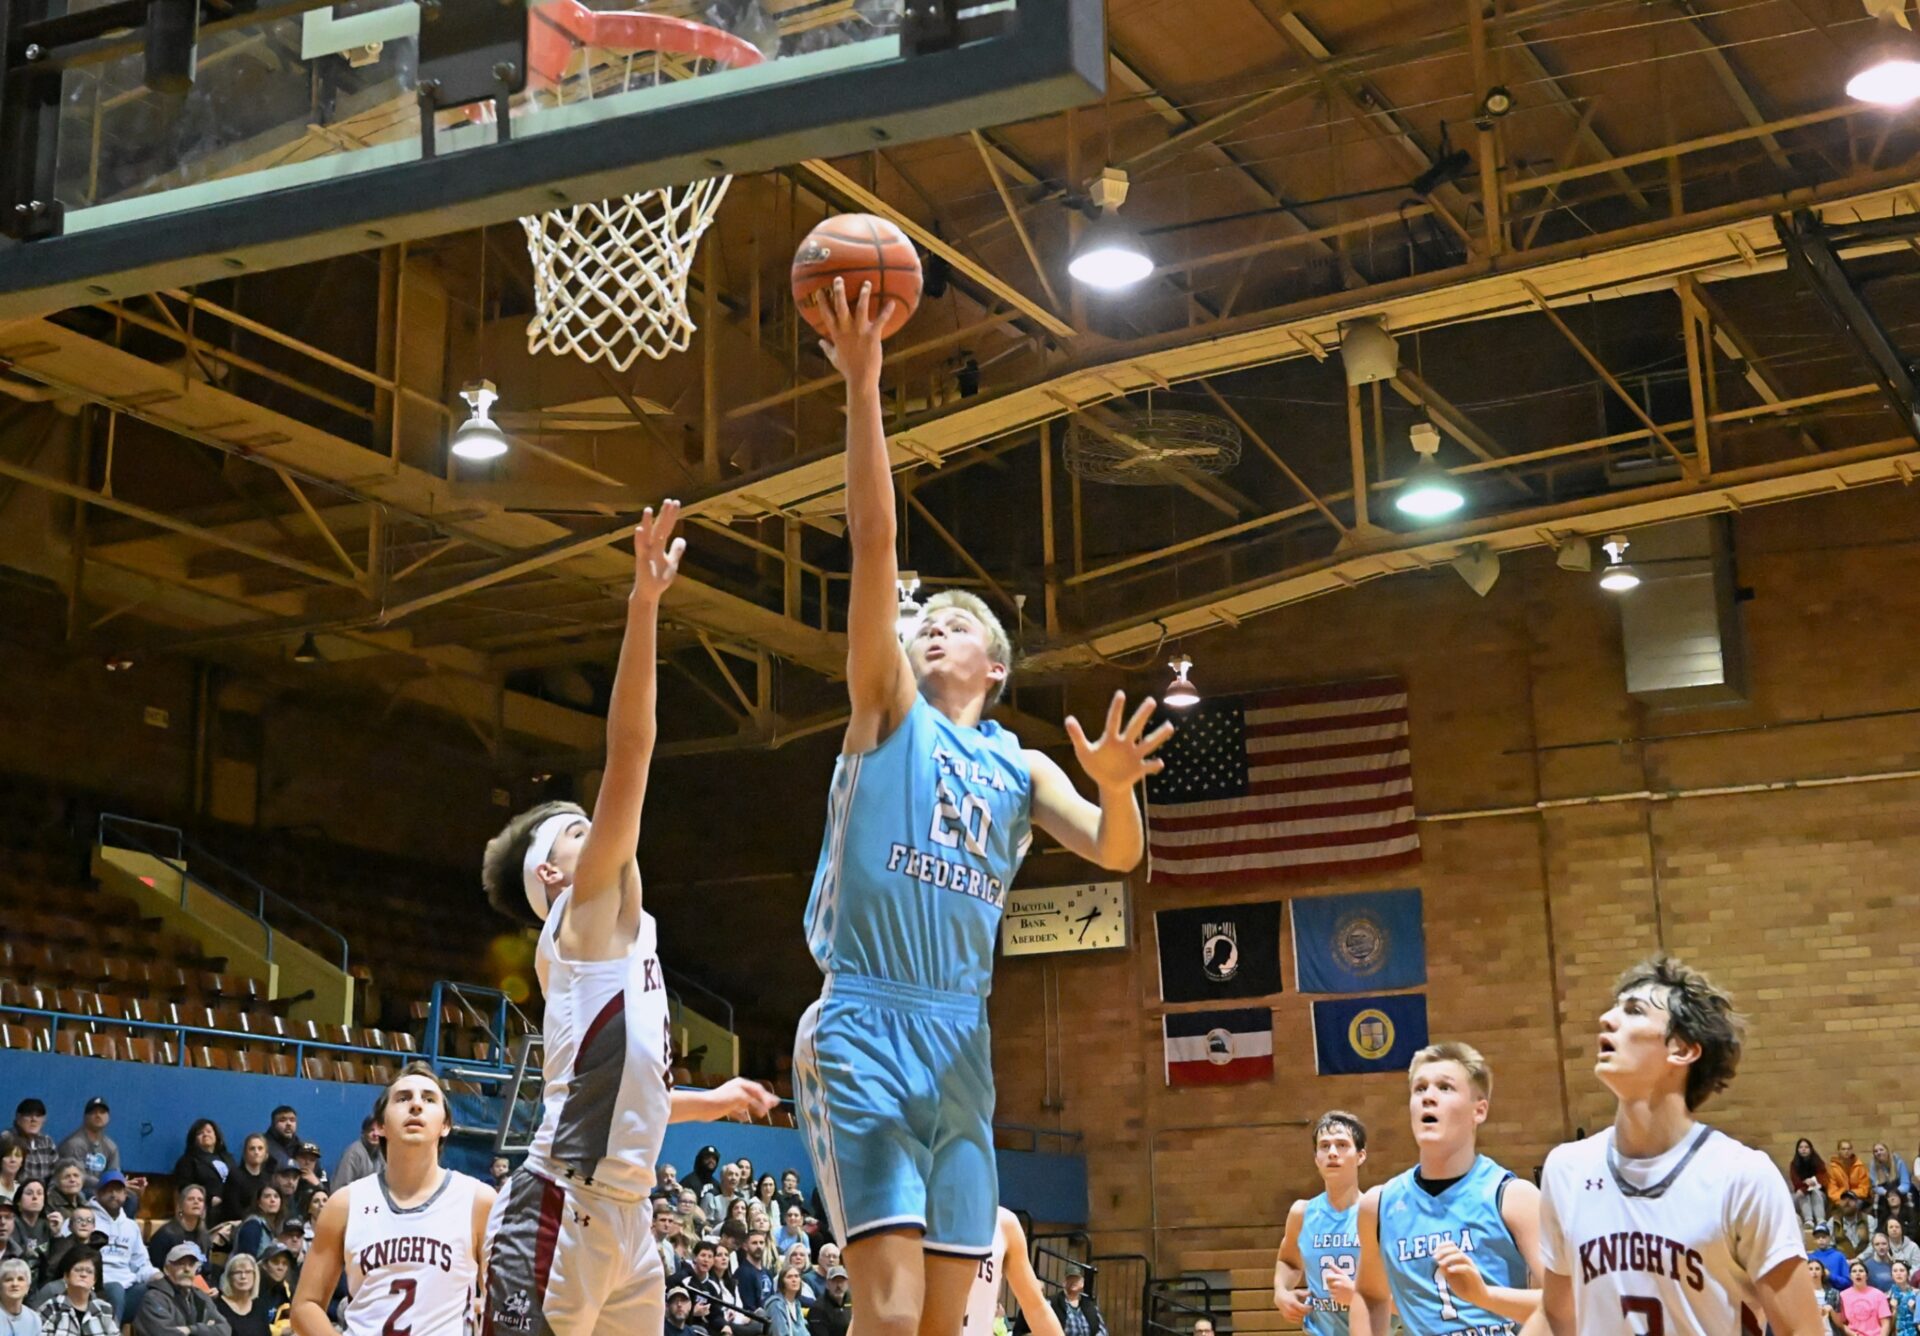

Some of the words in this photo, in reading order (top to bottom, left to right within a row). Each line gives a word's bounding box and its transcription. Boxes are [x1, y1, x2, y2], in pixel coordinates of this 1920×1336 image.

[930, 780, 993, 858] 20
[360, 1236, 453, 1275] KNIGHTS
[1313, 1233, 1361, 1249] LEOLA
[1579, 1231, 1705, 1292] KNIGHTS
[383, 1278, 418, 1336] 2
[1433, 1265, 1457, 1320] 1
